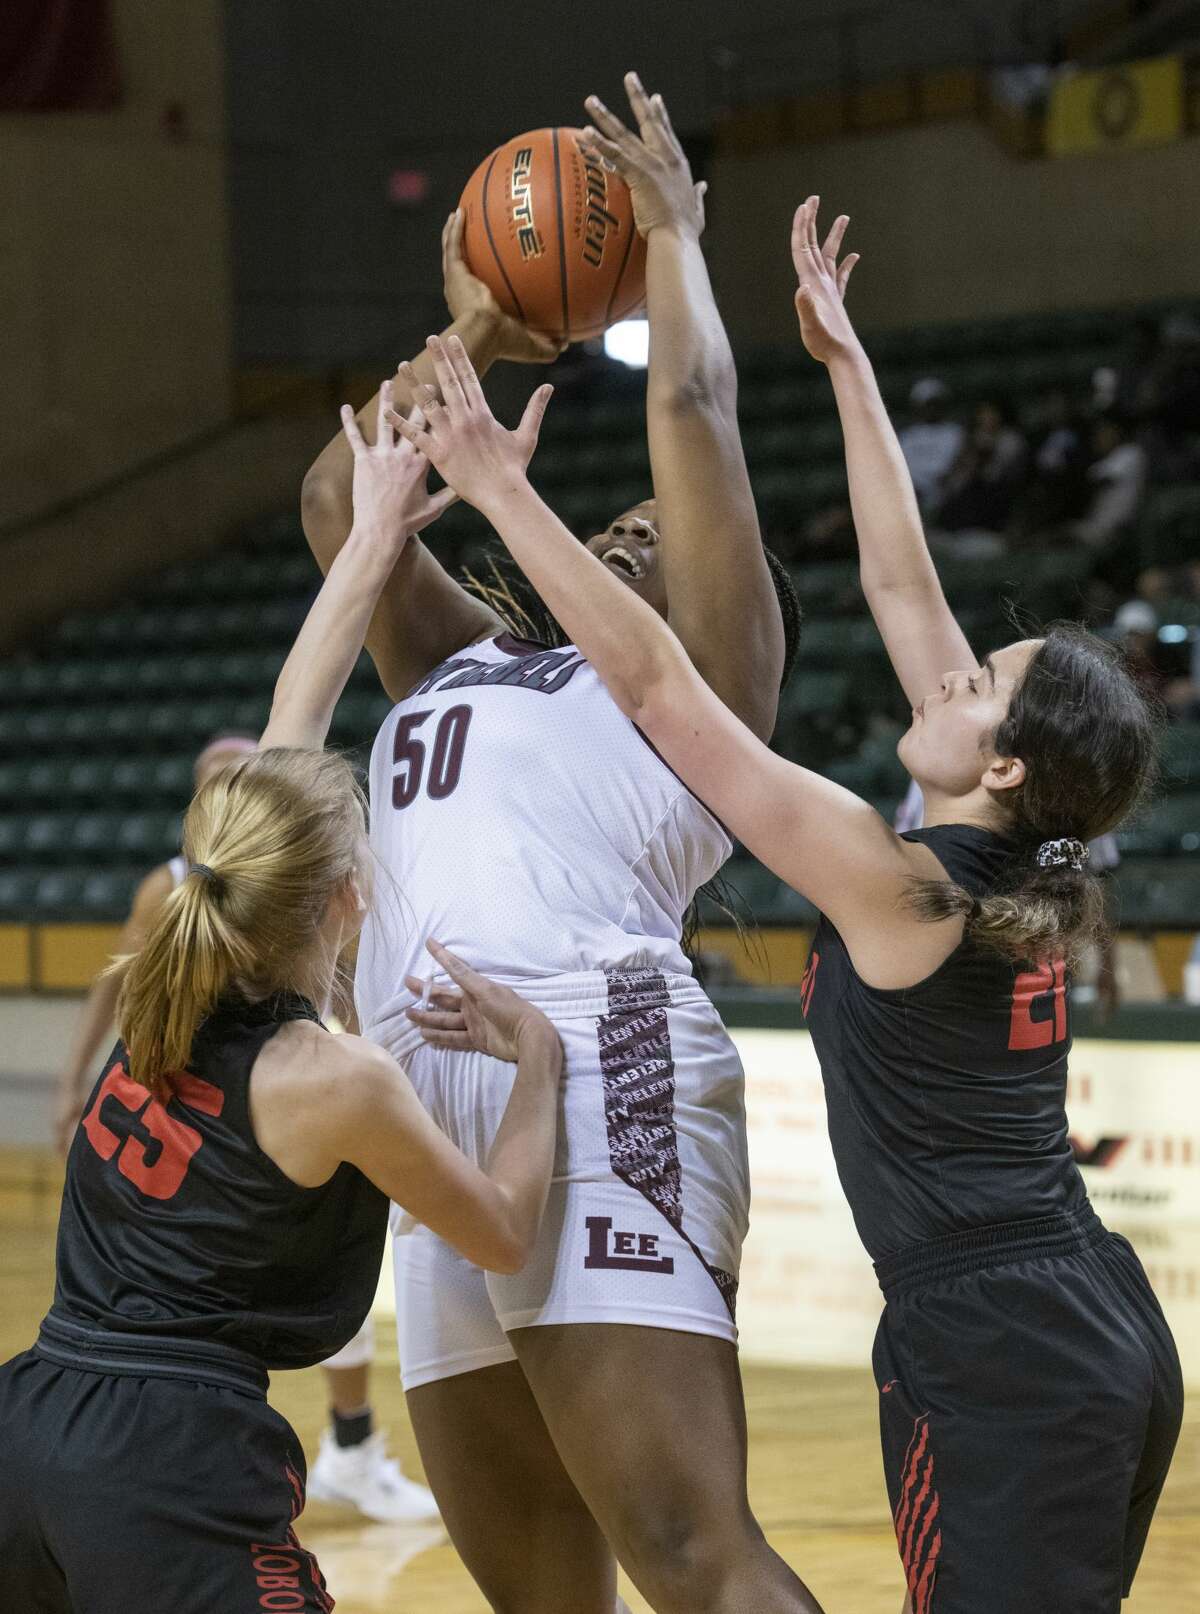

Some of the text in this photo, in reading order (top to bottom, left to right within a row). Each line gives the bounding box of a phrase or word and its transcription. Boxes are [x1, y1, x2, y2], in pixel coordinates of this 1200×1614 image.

[512, 147, 541, 260] ELITE
[573, 139, 619, 268] aden
[391, 703, 474, 811] 50
[249, 1543, 305, 1614] LOBO
